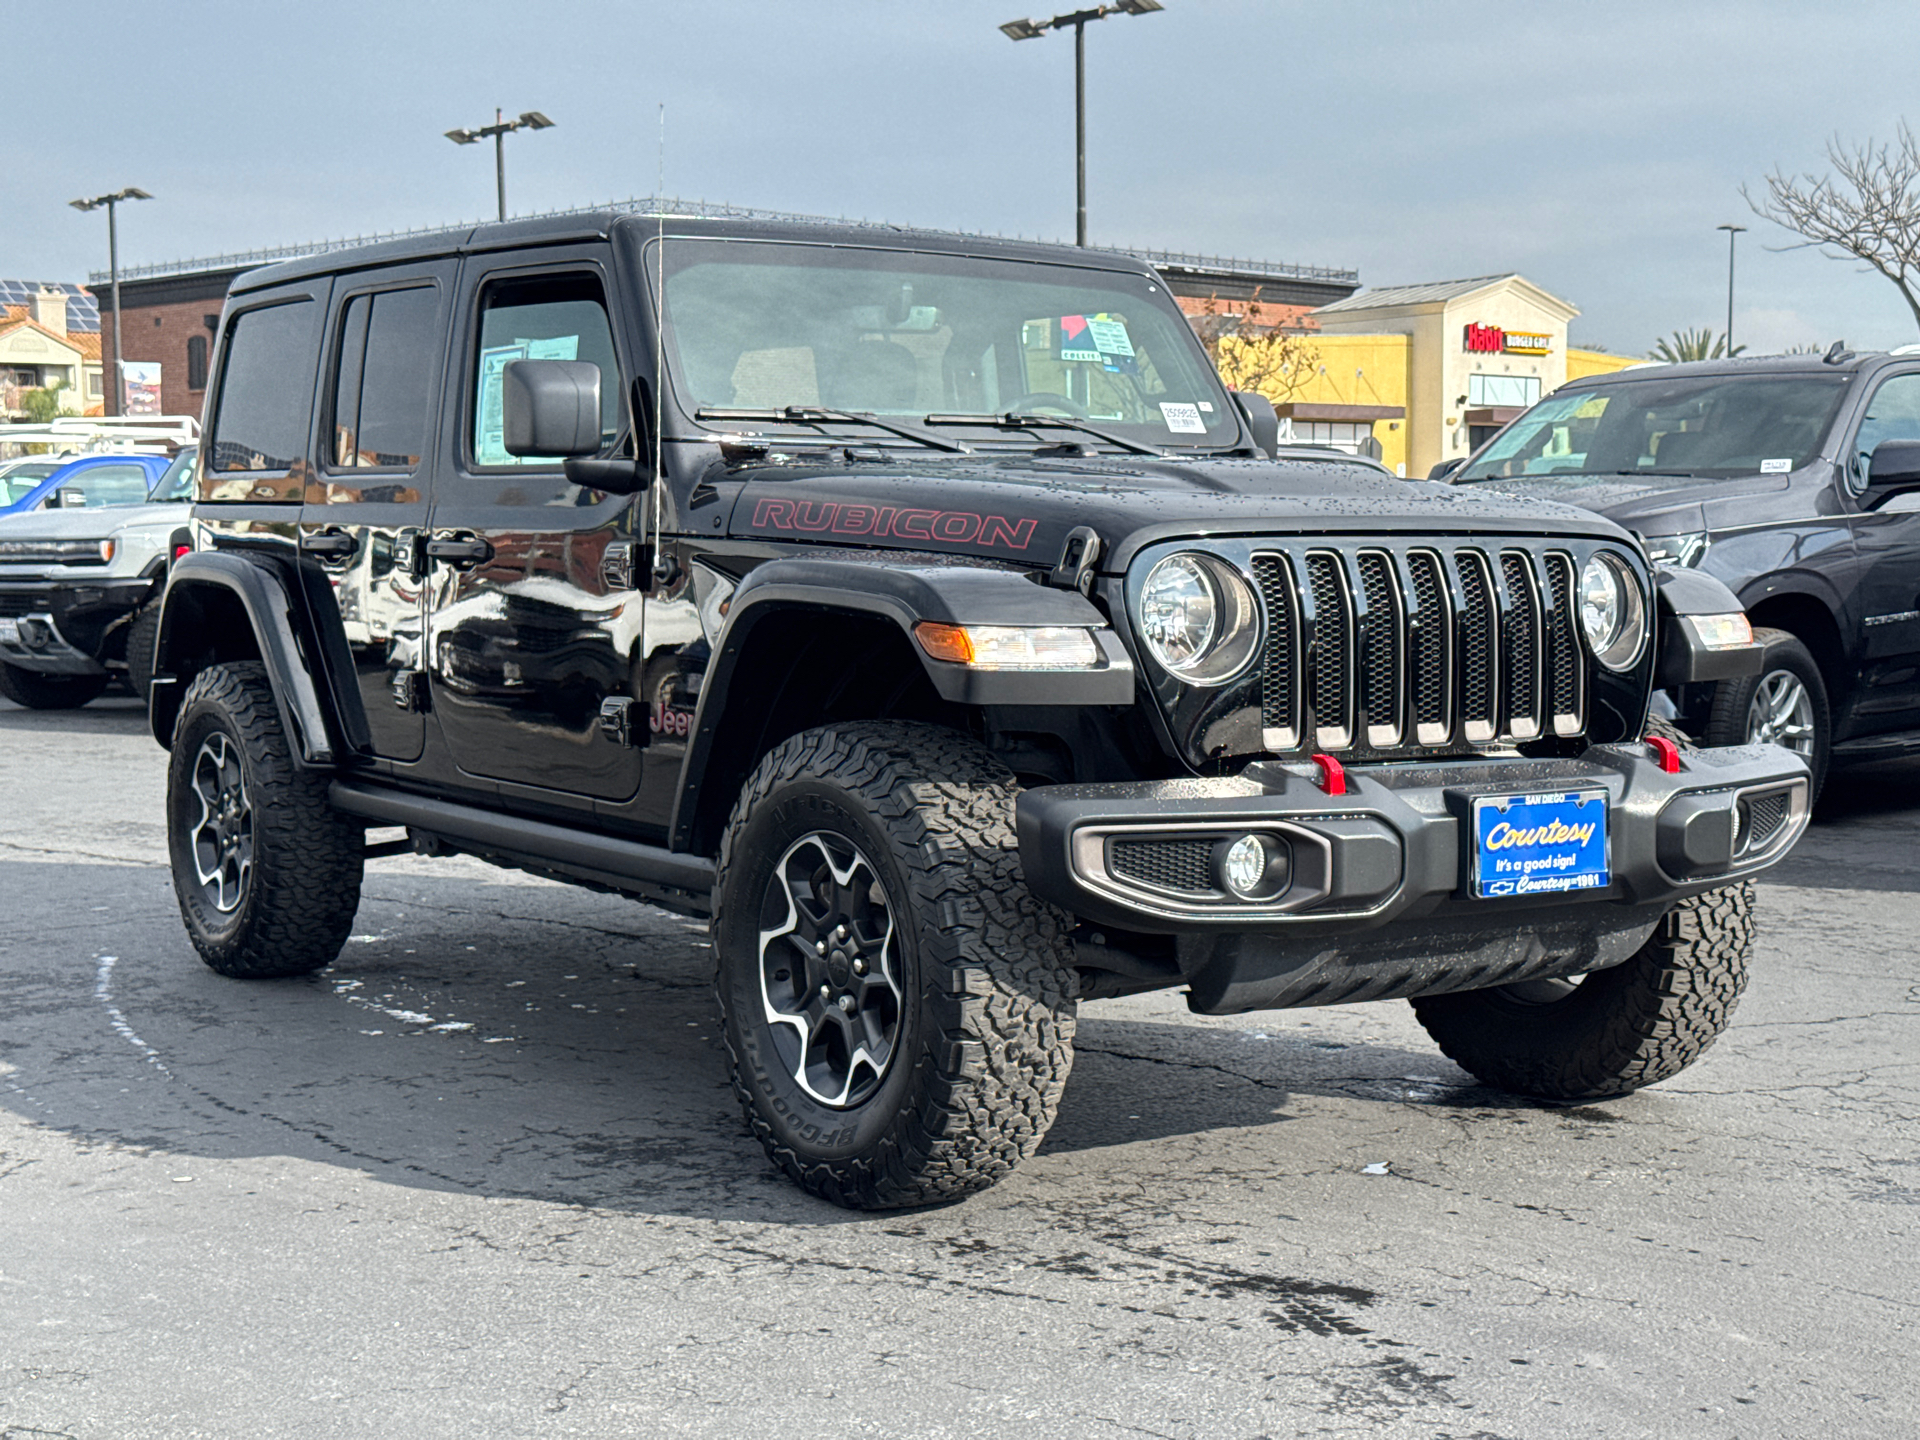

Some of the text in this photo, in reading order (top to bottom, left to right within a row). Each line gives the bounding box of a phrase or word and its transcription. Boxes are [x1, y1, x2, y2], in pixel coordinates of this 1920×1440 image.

[1466, 323, 1504, 352] Habit
[752, 498, 1038, 550] RUBICON
[1525, 793, 1566, 805] SAN DIEGO
[1485, 816, 1596, 851] Courtesy
[1496, 853, 1577, 874] It's a good sign!
[1516, 875, 1571, 894] Courtesy
[1576, 873, 1600, 888] 1961
